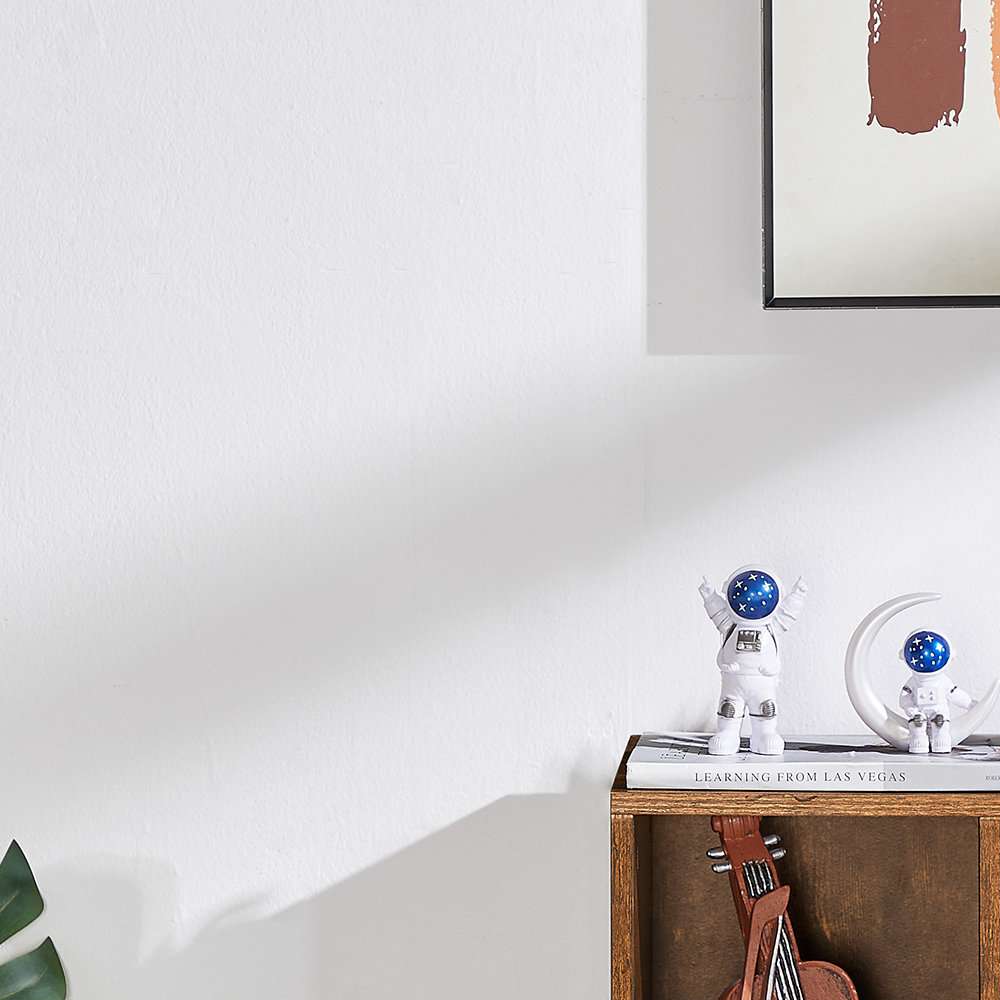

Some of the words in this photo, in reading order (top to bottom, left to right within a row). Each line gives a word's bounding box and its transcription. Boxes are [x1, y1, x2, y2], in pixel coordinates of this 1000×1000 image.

[695, 772, 771, 783] LEARNING
[777, 772, 817, 783] FROM
[824, 772, 851, 782] LAS
[858, 772, 907, 783] VEGAS
